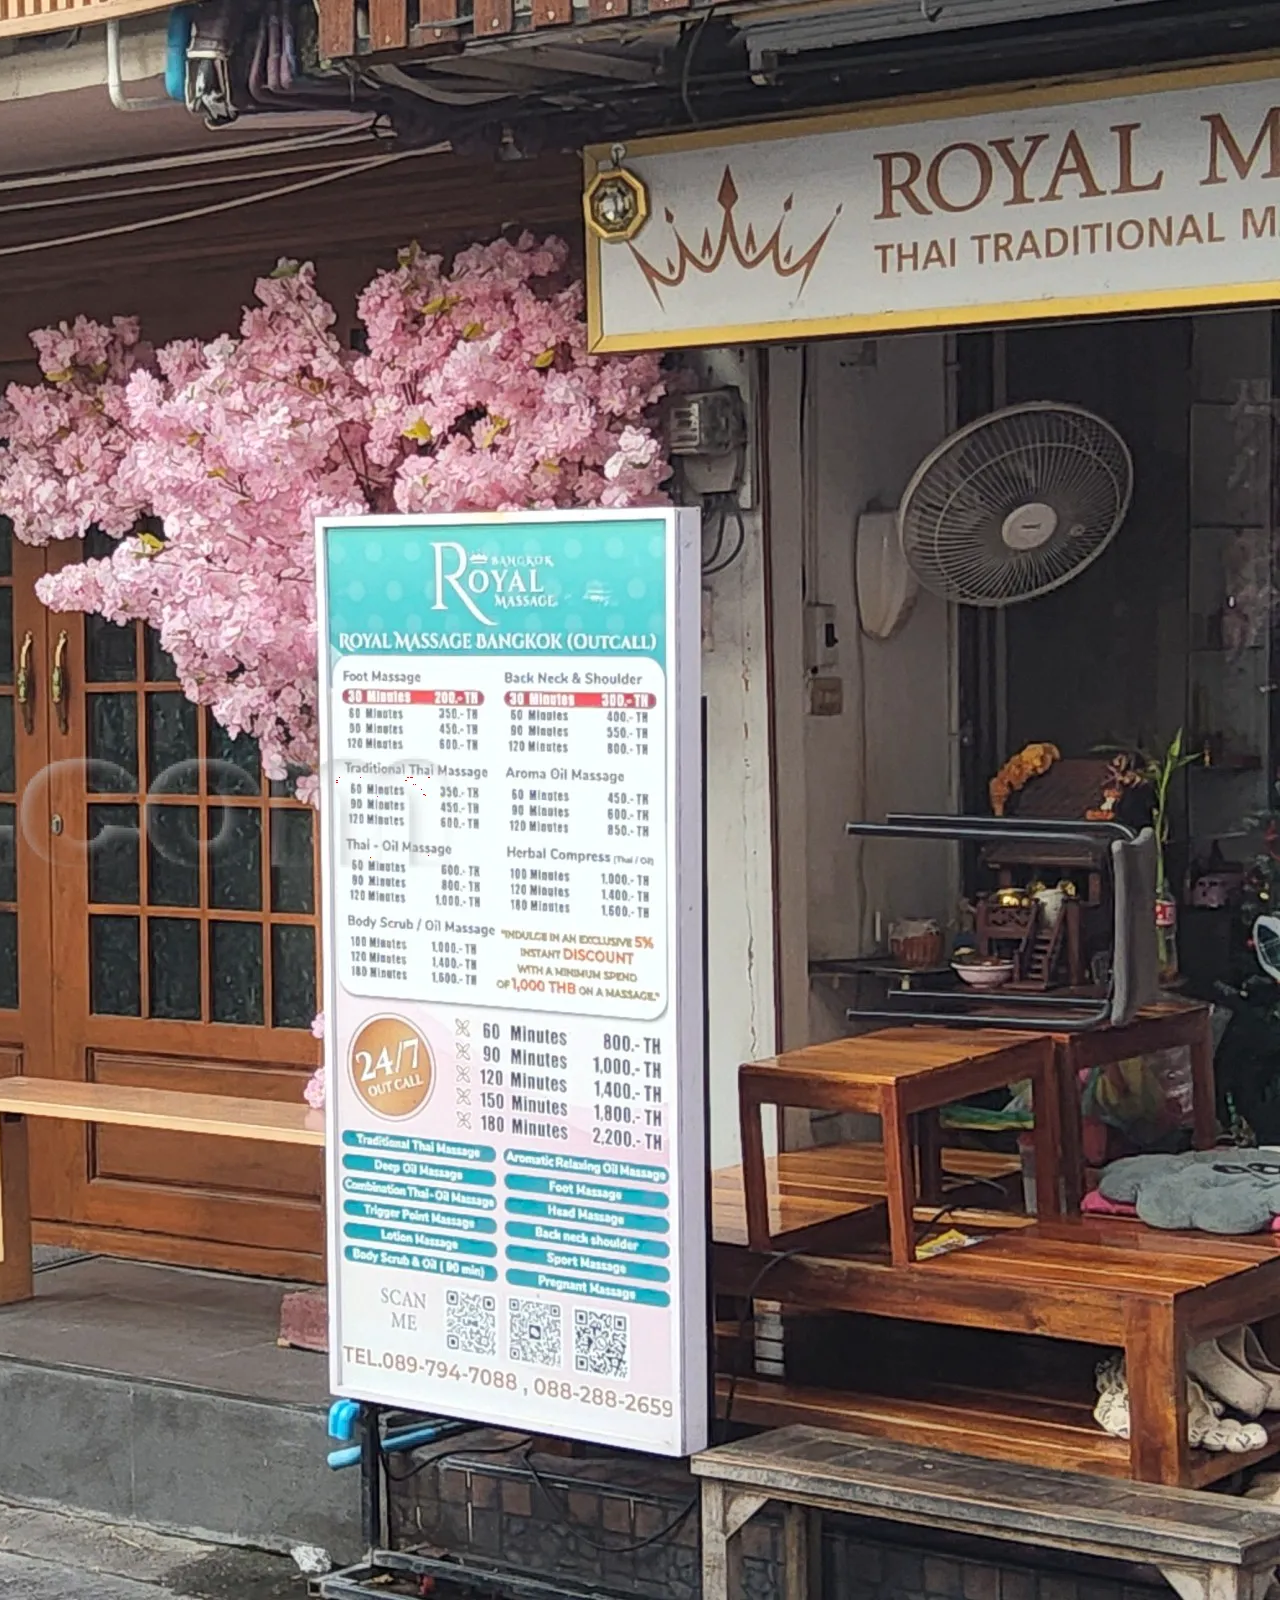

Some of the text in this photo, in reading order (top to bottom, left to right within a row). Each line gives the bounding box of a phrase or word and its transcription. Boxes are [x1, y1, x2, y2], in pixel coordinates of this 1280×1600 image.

[873, 121, 1165, 220] ROYAL
[874, 205, 1280, 274] THAI TRADITIONAL M
[491, 555, 554, 567] BANGKOK
[495, 595, 558, 609] MASSAGE
[339, 631, 390, 651] ROYAL
[393, 630, 471, 651] MASSAGE
[476, 632, 562, 650] BANGKOK
[343, 671, 421, 684] Foot Massage
[504, 672, 642, 685] Back Neck & Shoulder
[348, 691, 362, 702] 30
[366, 690, 410, 703] Minutes
[510, 692, 524, 705] 30
[529, 693, 575, 706] Minutes
[345, 762, 488, 780] Traditional Thai Massage
[506, 767, 624, 784] Aroma Oil Massage
[346, 838, 370, 850] Thai
[383, 840, 398, 851] Oil
[402, 842, 452, 856] Massage
[507, 846, 611, 863] Herbal Compress
[348, 915, 495, 937] Body Scrub / Oil Massage
[550, 933, 559, 942] IN
[562, 934, 576, 943] AN
[579, 935, 632, 947] EXCLUSIVE
[635, 937, 654, 949] 5%
[521, 948, 634, 965] INSTANT DISCOUNT
[517, 964, 637, 982] WITH A MINIMUM SPEND
[497, 980, 509, 988] OF
[512, 978, 545, 992] 1,000
[549, 981, 576, 994] THB
[579, 986, 593, 996] ON
[596, 988, 603, 997] A
[483, 1023, 500, 1039] 60
[511, 1025, 567, 1046] Minutes
[356, 1038, 419, 1082] 24/7
[484, 1046, 500, 1062] 90
[511, 1049, 567, 1069] Minutes
[368, 1075, 424, 1097] OUT CALL
[480, 1069, 502, 1085] 120
[511, 1072, 567, 1092] Minutes
[481, 1093, 504, 1109] 150
[512, 1095, 568, 1116] Minutes
[481, 1116, 504, 1132] 180
[512, 1119, 568, 1140] Minutes
[356, 1133, 480, 1159] Traditional Thai Massage
[374, 1159, 463, 1181] Deep Oil Massage
[507, 1151, 666, 1181] Aromatic Relaxing Oil Massage
[344, 1179, 406, 1195] Combination
[452, 1192, 495, 1207] Massage
[549, 1181, 622, 1201] Foot Massage
[364, 1204, 475, 1229] Trigger Point Massage
[548, 1205, 624, 1225] Head Massage
[381, 1229, 458, 1250] Lotion Massage
[536, 1227, 638, 1251] Back neck shoulder
[353, 1248, 378, 1263] Body
[381, 1253, 409, 1266] Scrub
[412, 1257, 420, 1267] &
[422, 1258, 436, 1270] Oil
[547, 1253, 626, 1274] Sport Massage
[538, 1274, 636, 1300] Pregnant Massage
[380, 1287, 426, 1309] SCAN
[391, 1312, 417, 1331] ME
[535, 1379, 673, 1418] 088-288-2659
